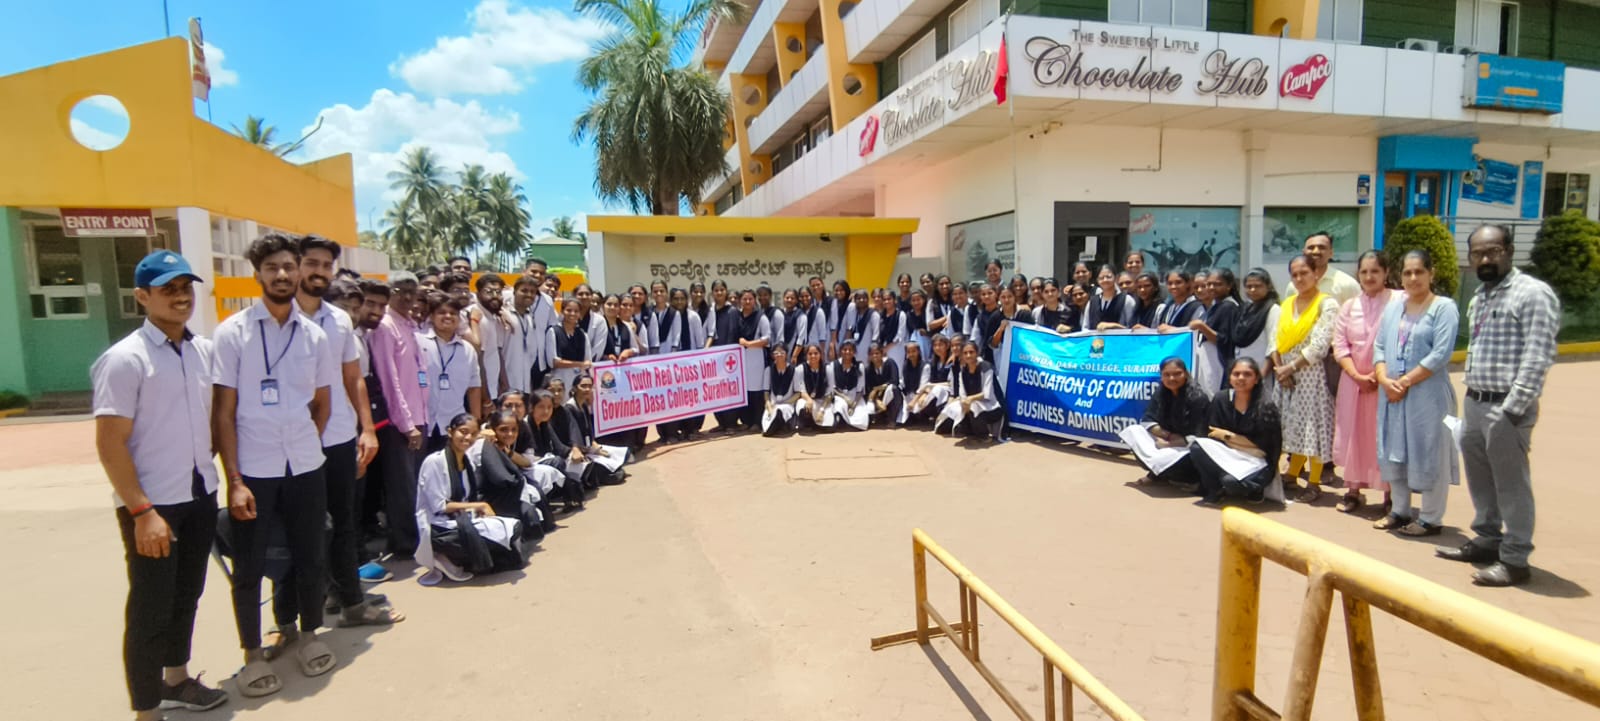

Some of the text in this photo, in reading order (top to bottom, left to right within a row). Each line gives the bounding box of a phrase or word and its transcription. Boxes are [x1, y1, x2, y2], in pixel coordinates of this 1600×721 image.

[1072, 28, 1199, 51] THE SWEETEST LITTLE
[1024, 35, 1270, 97] Chocolate Hub
[1283, 61, 1332, 93] Campco
[64, 215, 150, 229] ENTRY POINT
[624, 358, 717, 392] Youth Red Cross Unit
[1016, 367, 1087, 395] ASSOCIATION
[1087, 378, 1106, 398] OF
[601, 396, 642, 421] Govinda
[644, 393, 666, 414] Dasa
[702, 377, 740, 401] Surathkal
[1016, 400, 1065, 426] BUSINESS
[1075, 397, 1093, 409] And
